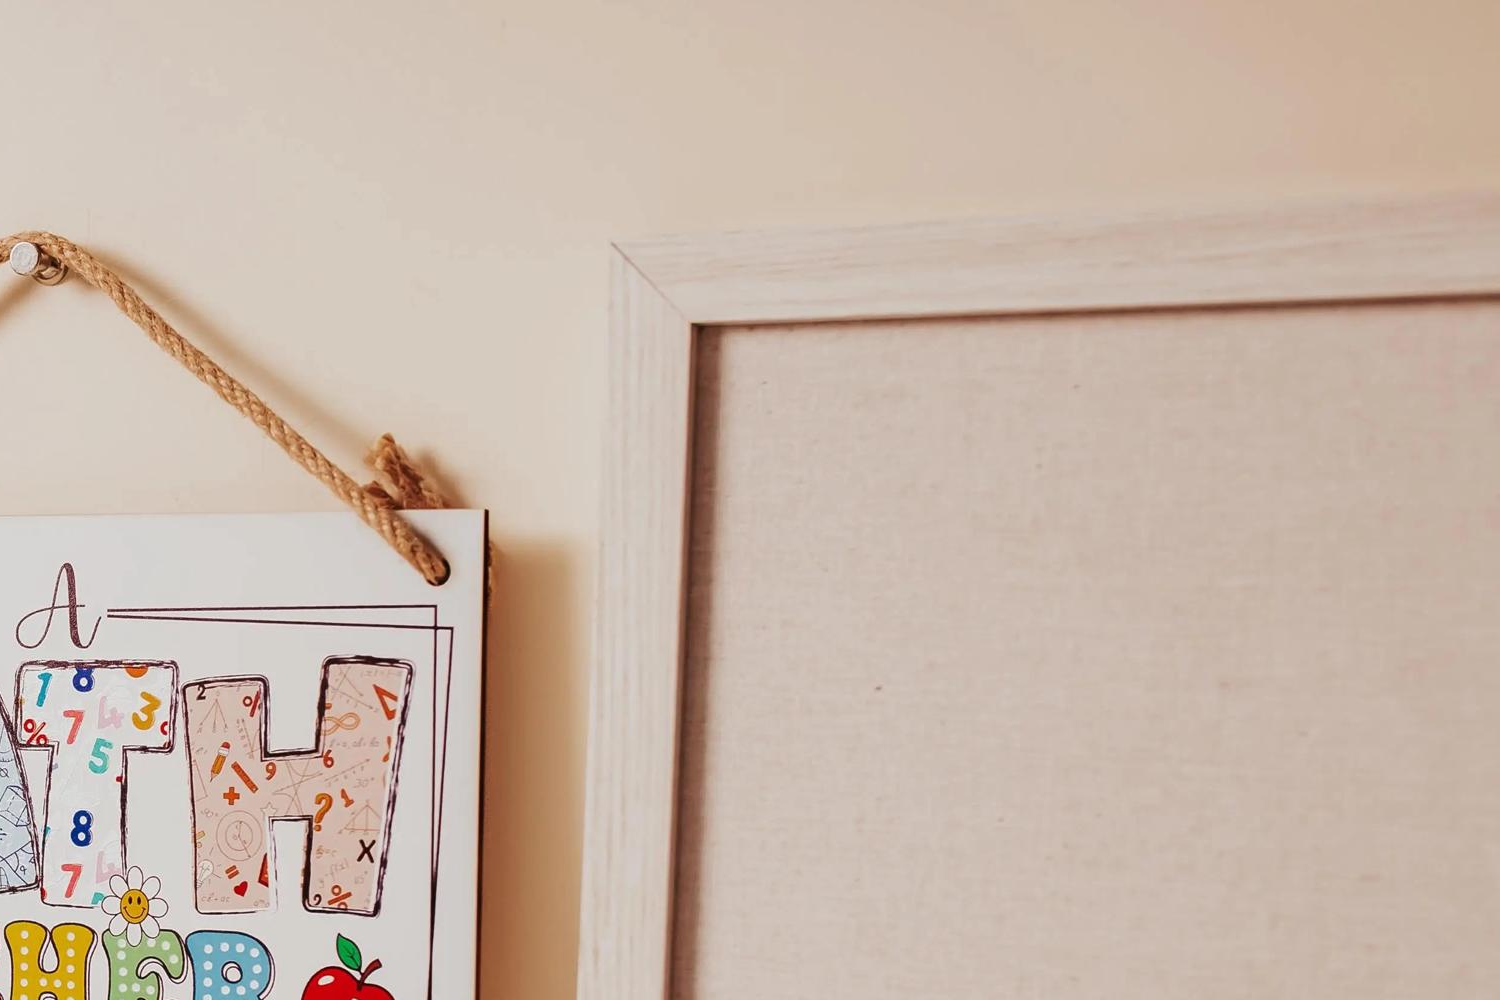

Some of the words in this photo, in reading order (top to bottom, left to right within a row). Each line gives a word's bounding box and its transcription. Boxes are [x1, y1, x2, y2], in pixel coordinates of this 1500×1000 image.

[15, 562, 102, 649] A
[63, 709, 85, 744] 7
[132, 691, 162, 730] 3
[88, 737, 113, 774] 5
[70, 809, 94, 847] 8
[61, 863, 83, 898] 7
